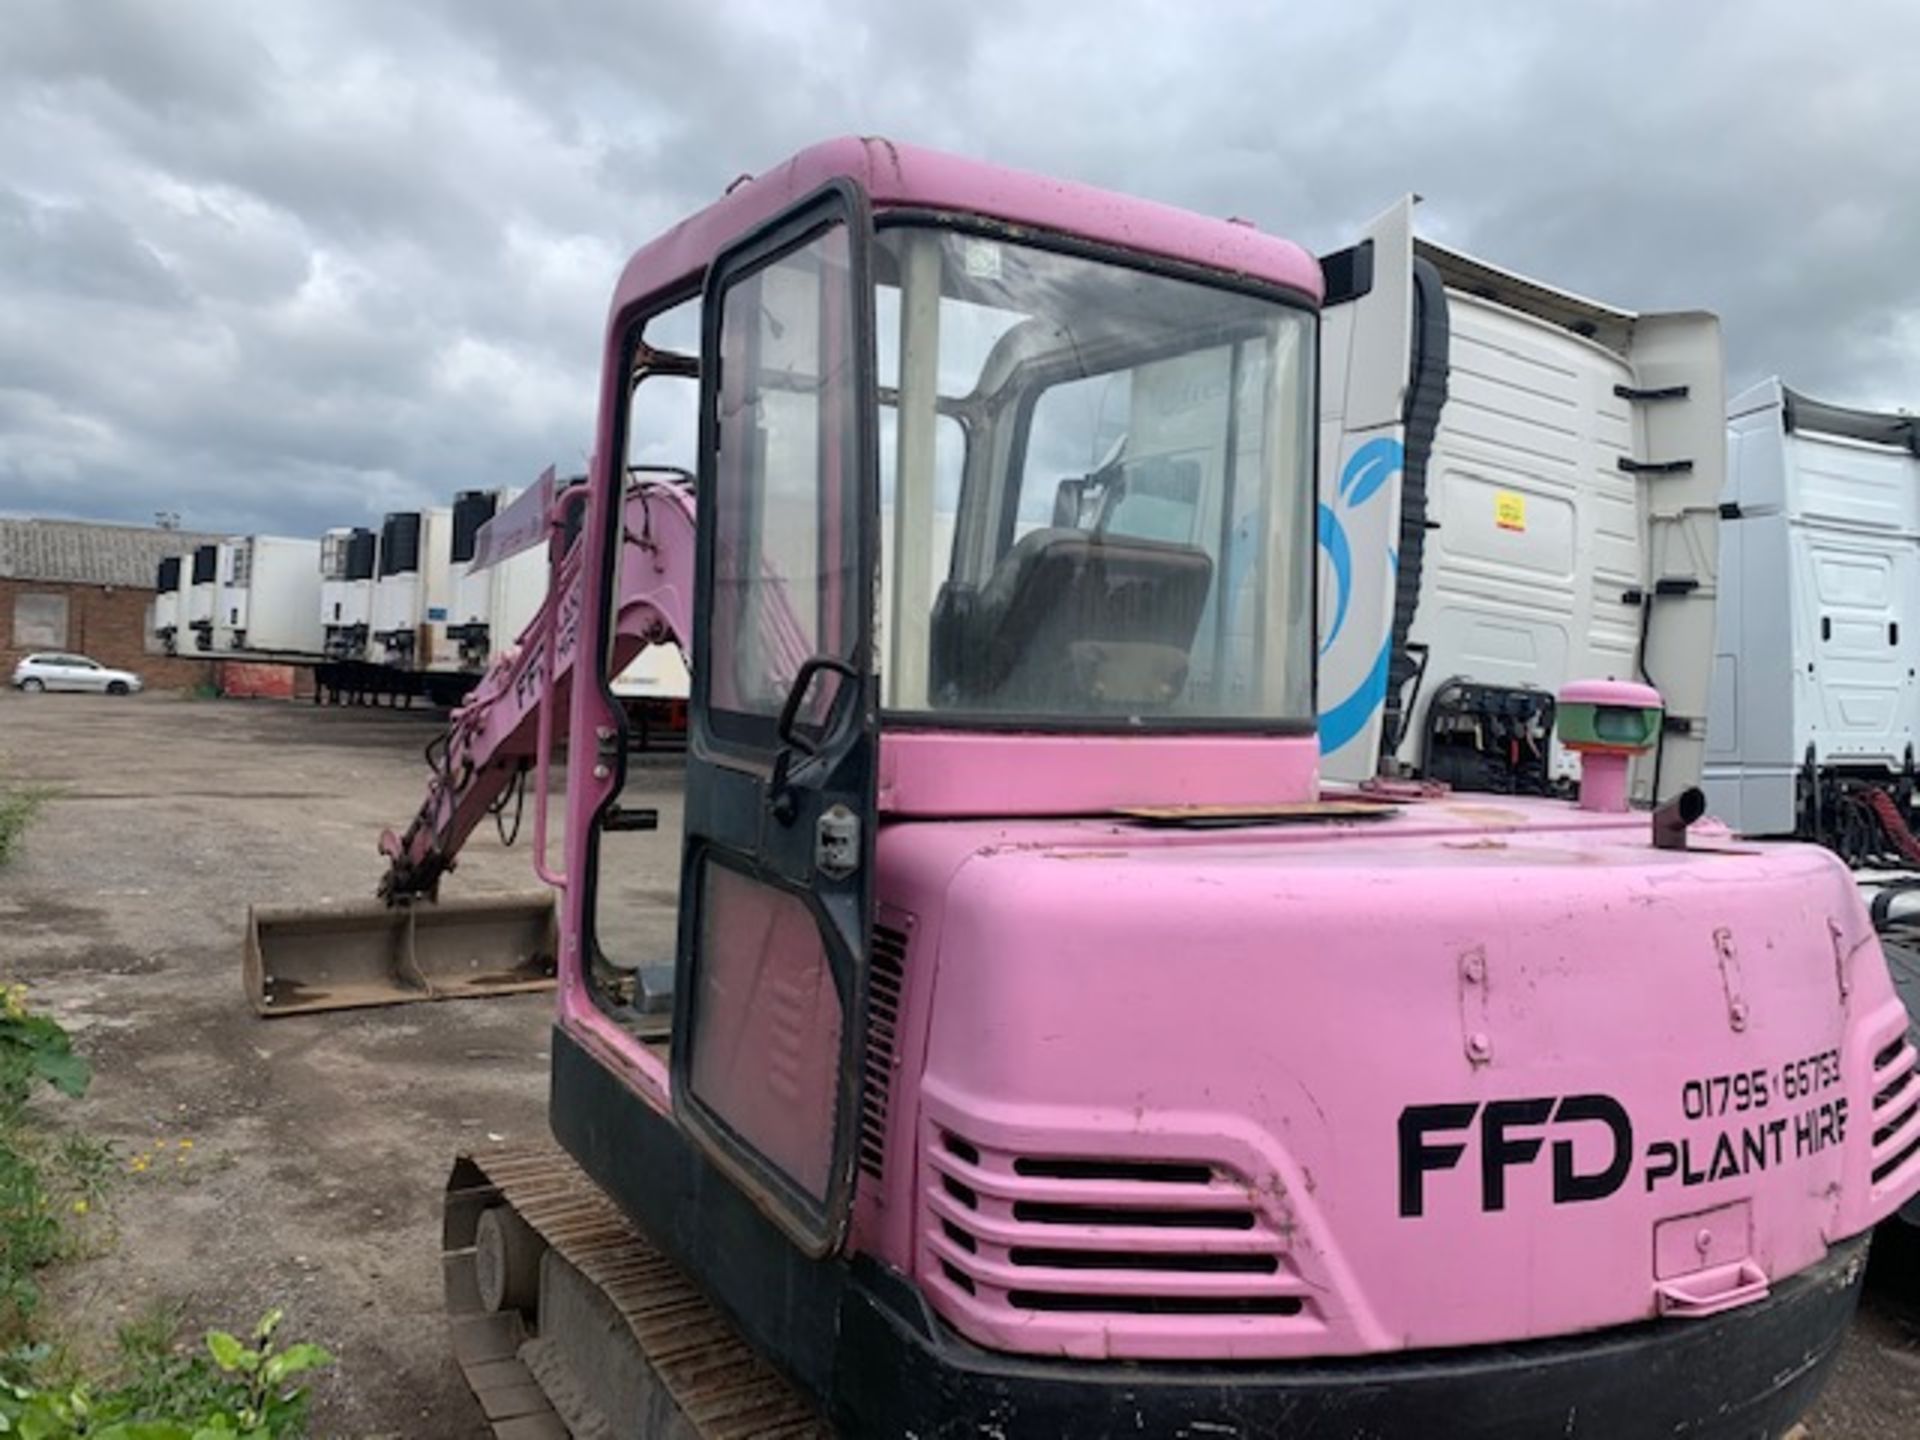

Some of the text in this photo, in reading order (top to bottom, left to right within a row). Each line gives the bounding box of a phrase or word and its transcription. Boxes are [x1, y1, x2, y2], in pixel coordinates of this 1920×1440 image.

[1682, 1068, 1768, 1120] 01795
[1397, 1093, 1633, 1218] FFD
[1645, 1097, 1848, 1192] PLANT HIRE
